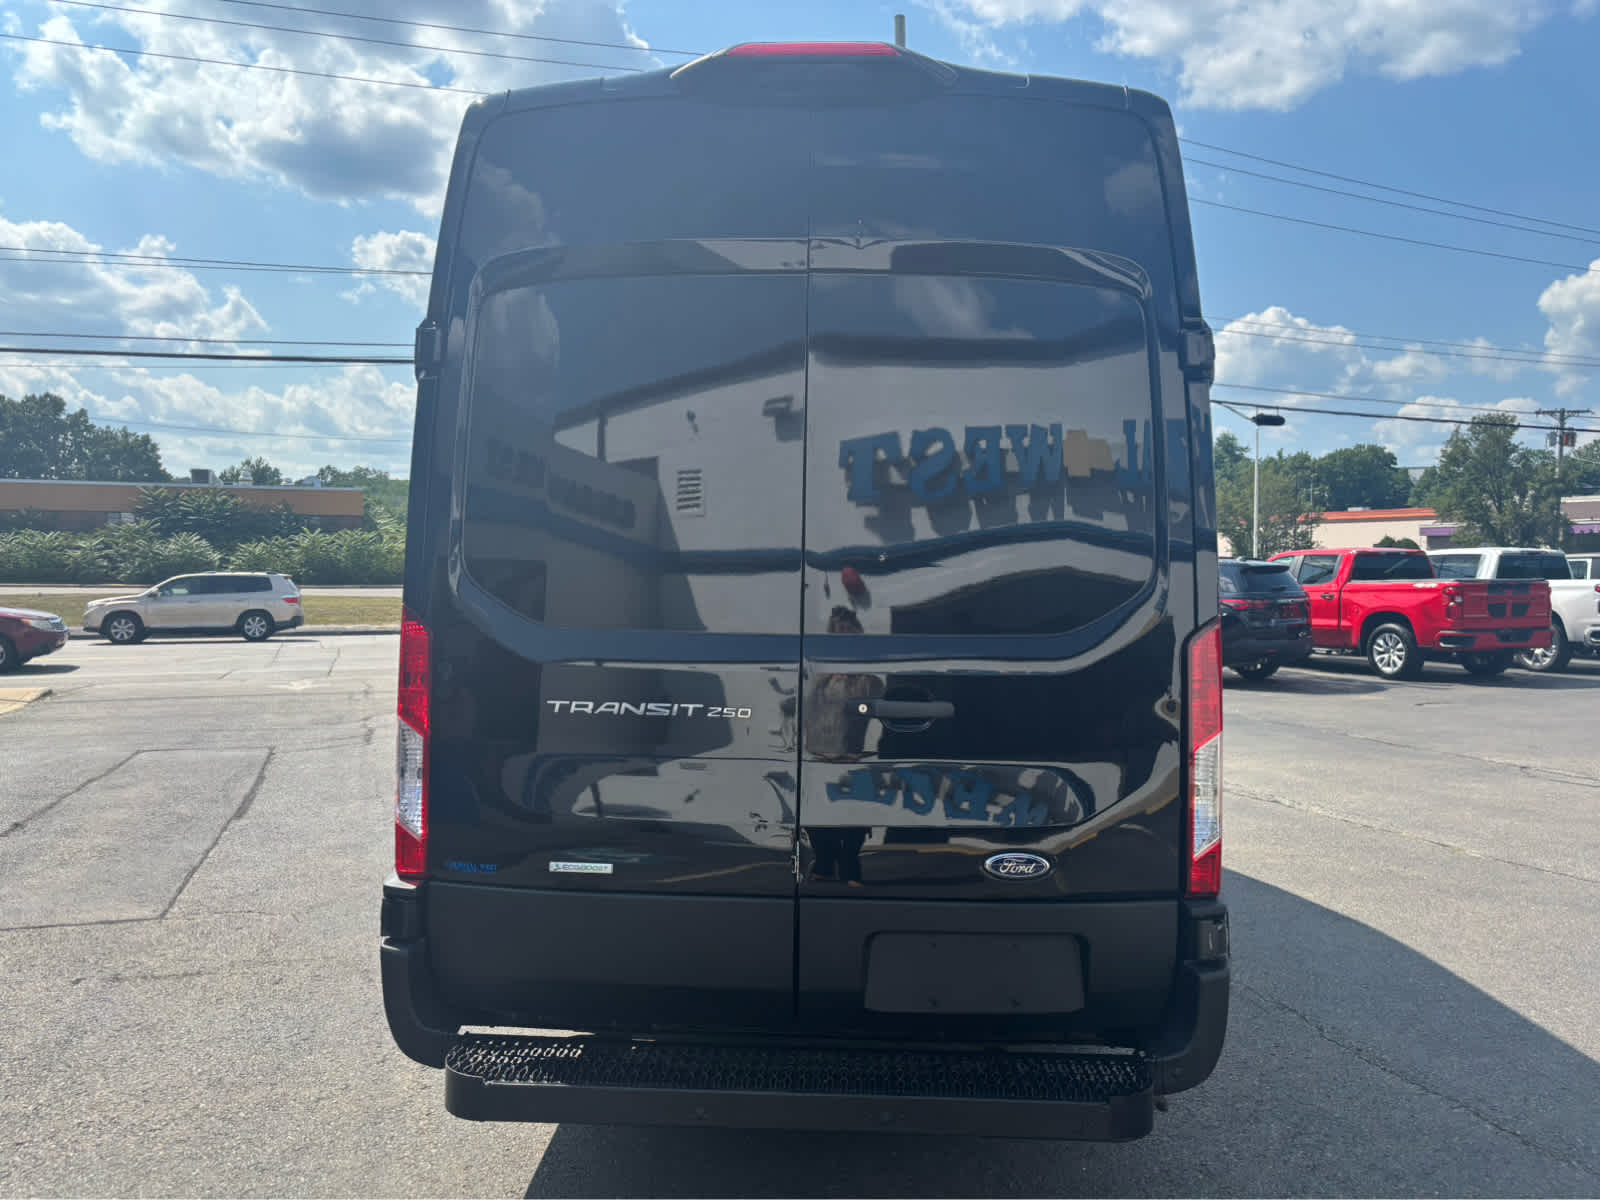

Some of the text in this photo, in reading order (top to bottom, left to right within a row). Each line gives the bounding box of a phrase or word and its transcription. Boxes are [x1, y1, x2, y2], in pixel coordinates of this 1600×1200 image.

[546, 699, 752, 719] TRANSIT 250
[999, 858, 1036, 874] Ford
